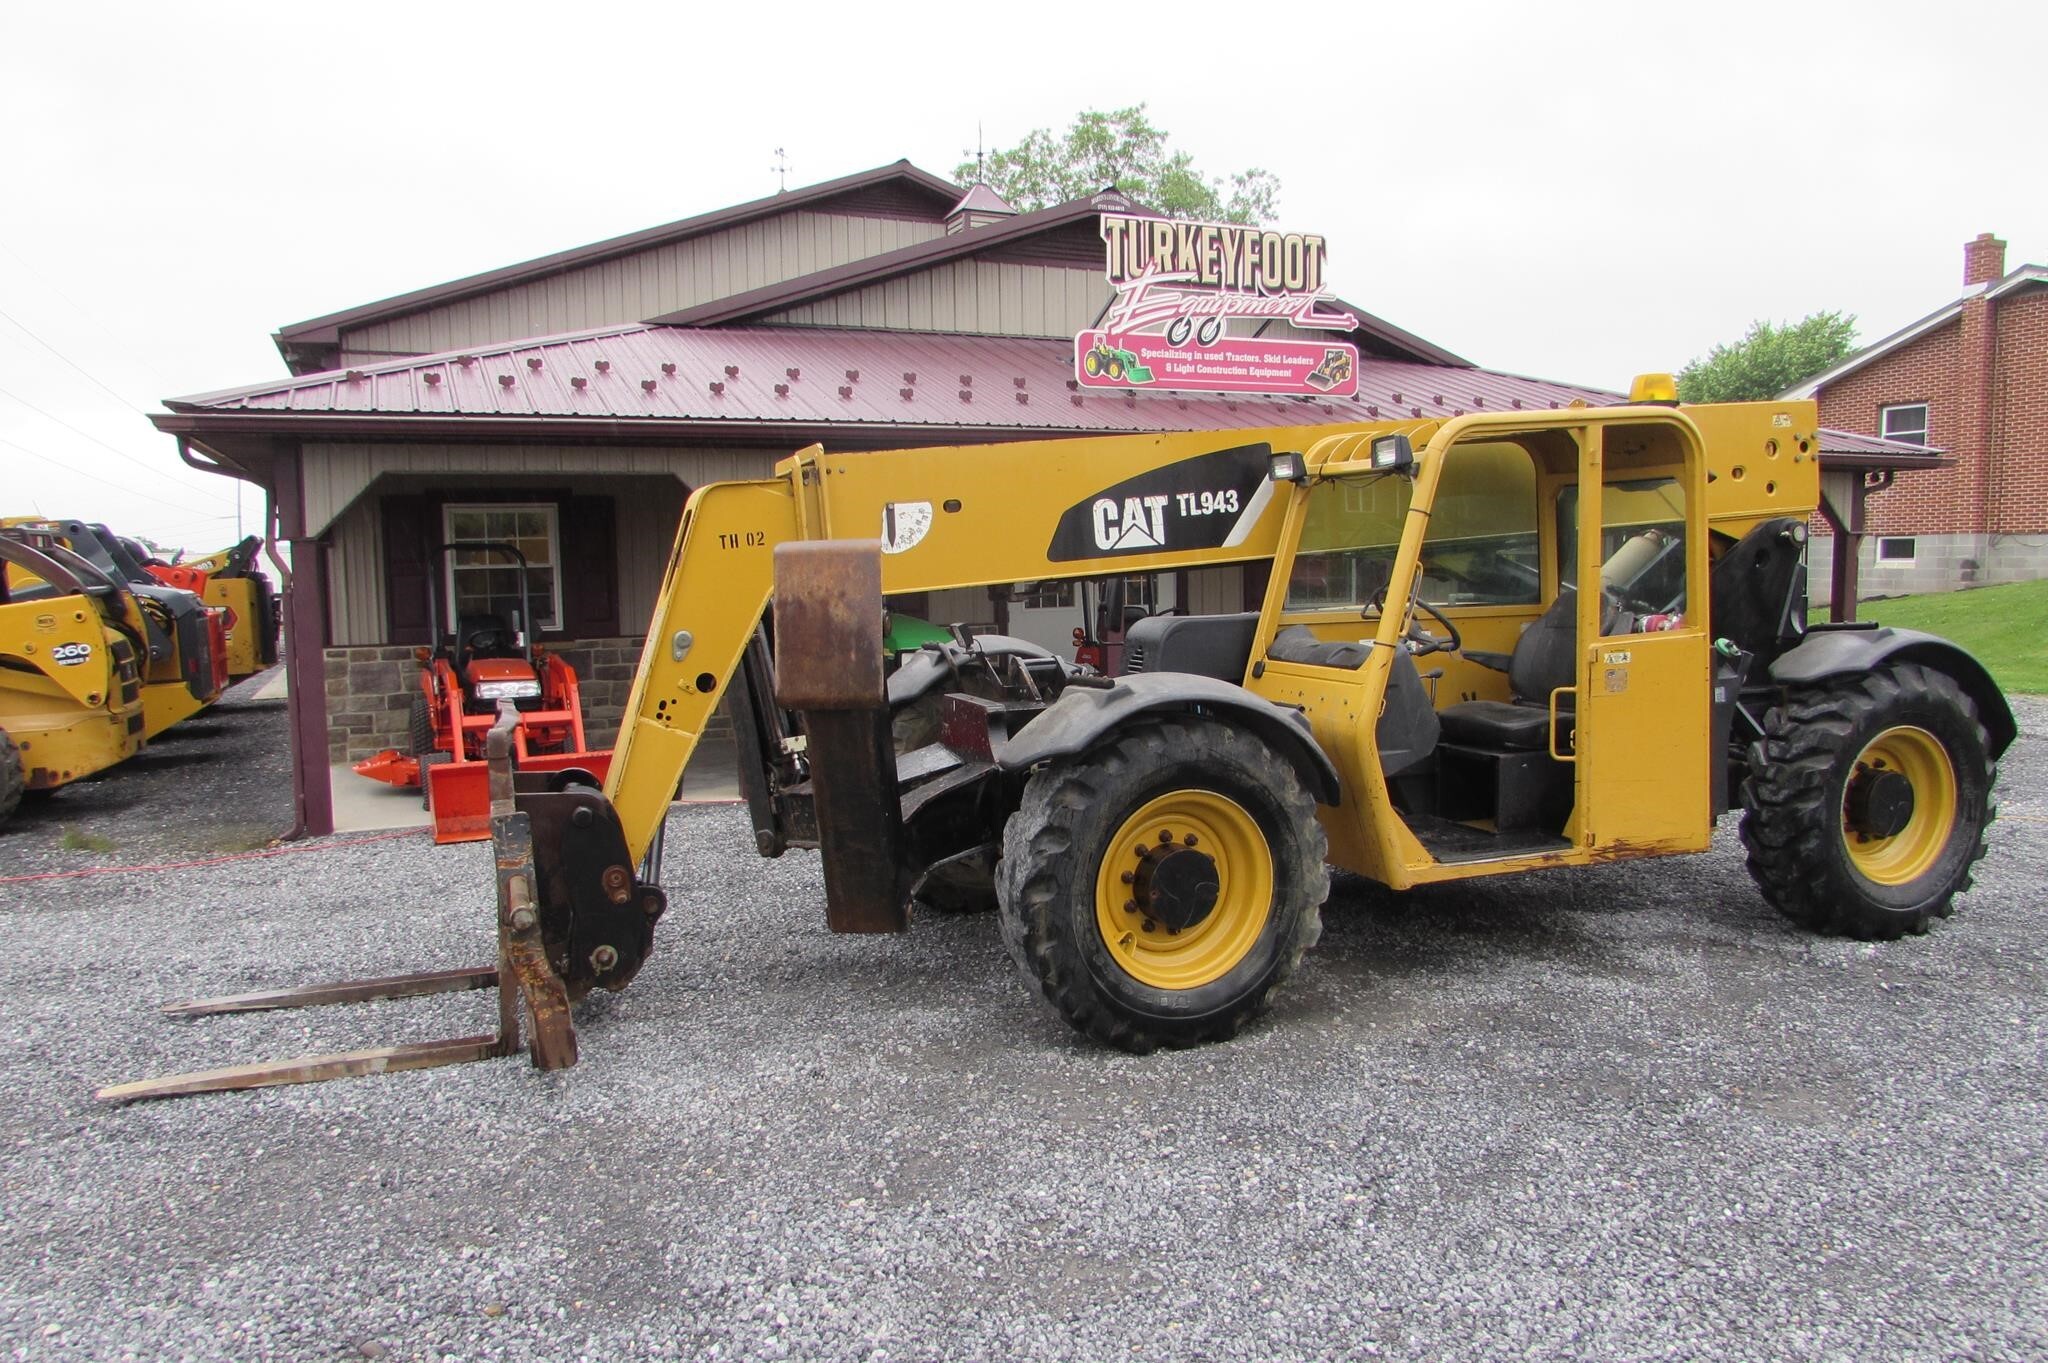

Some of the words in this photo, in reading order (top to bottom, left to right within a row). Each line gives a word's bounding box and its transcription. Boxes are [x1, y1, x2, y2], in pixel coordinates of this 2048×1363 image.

[1105, 216, 1326, 294] TURKEYFOOT
[1110, 264, 1353, 342] Equipment
[1141, 347, 1193, 361] Specializing
[1194, 351, 1203, 361] in
[1204, 352, 1224, 362] used
[1263, 354, 1282, 364] Skid
[1283, 355, 1314, 365] Loaders
[1165, 363, 1172, 372] &
[1174, 364, 1195, 374] Light
[1197, 365, 1248, 376] Construction
[1249, 367, 1292, 378] Equipment
[1093, 496, 1169, 550] CAT
[1176, 489, 1240, 517] TL943
[719, 533, 739, 550] TH
[746, 531, 765, 547] 02
[52, 643, 92, 659] 260
